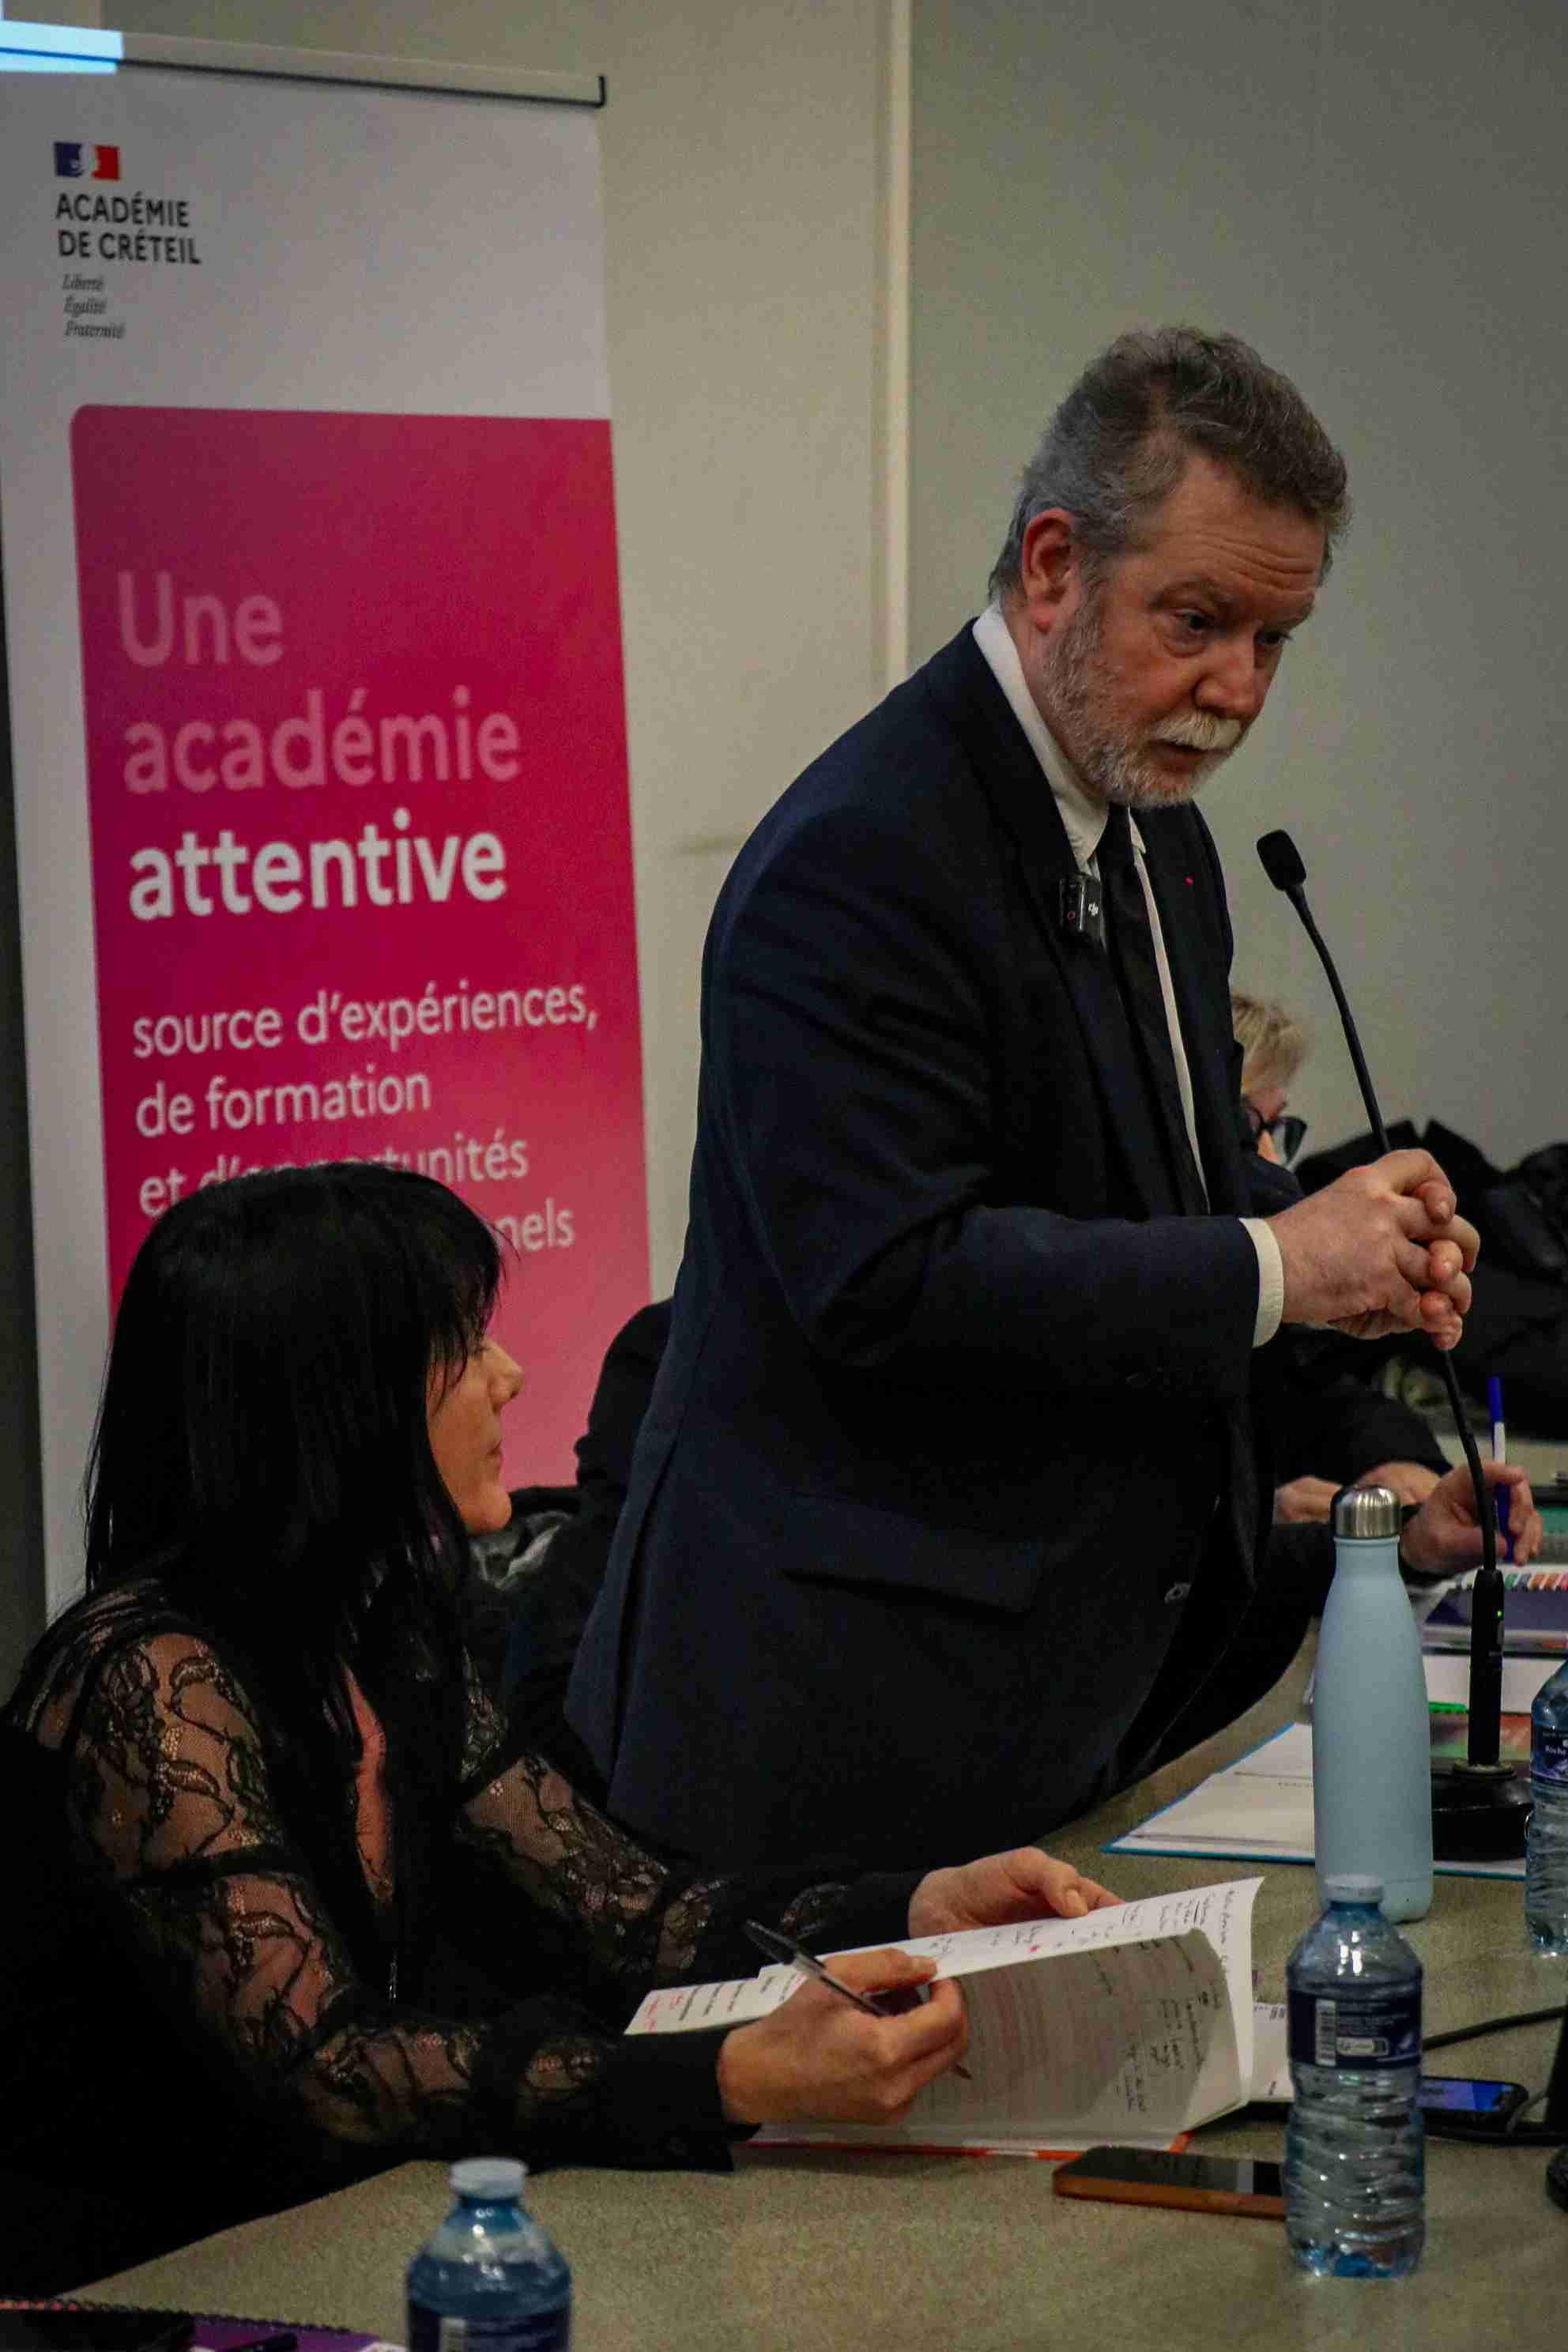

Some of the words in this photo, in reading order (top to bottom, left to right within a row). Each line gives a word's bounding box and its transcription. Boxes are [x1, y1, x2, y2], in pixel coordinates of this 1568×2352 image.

[55, 191, 190, 228] ACADÉMIE
[58, 229, 92, 258] DE
[98, 229, 202, 265] CRÉTEIL
[118, 571, 285, 666] Une
[123, 685, 520, 794] académie
[129, 806, 507, 921] attentive
[132, 1005, 283, 1057] source
[135, 1080, 194, 1137] de
[205, 1064, 432, 1130] formation
[139, 1167, 187, 1218] et
